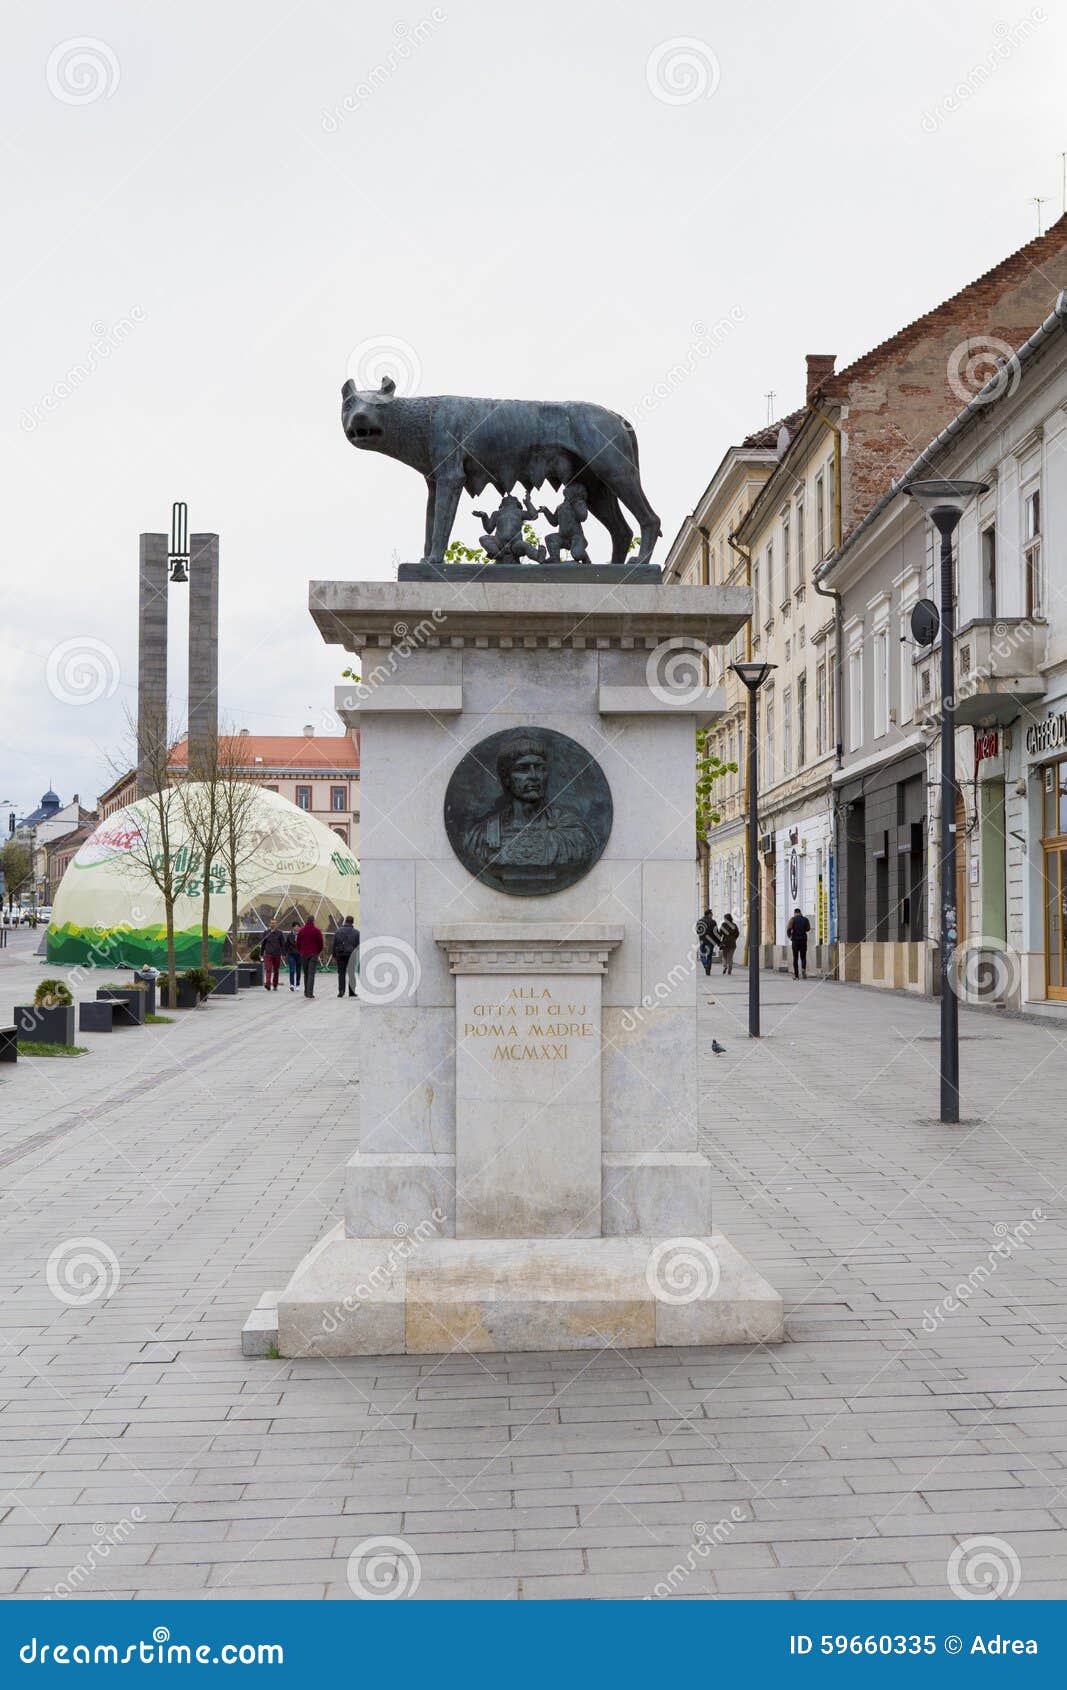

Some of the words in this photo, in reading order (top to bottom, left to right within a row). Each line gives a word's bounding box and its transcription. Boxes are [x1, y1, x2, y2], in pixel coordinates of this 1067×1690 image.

[211, 864, 226, 878] de
[509, 987, 552, 999] ALLA
[525, 1005, 539, 1016] DI
[547, 1005, 586, 1016] CLVJ
[464, 1023, 518, 1037] ROMA
[528, 1023, 593, 1037] MADRE
[493, 1044, 568, 1061] MCMXXI
